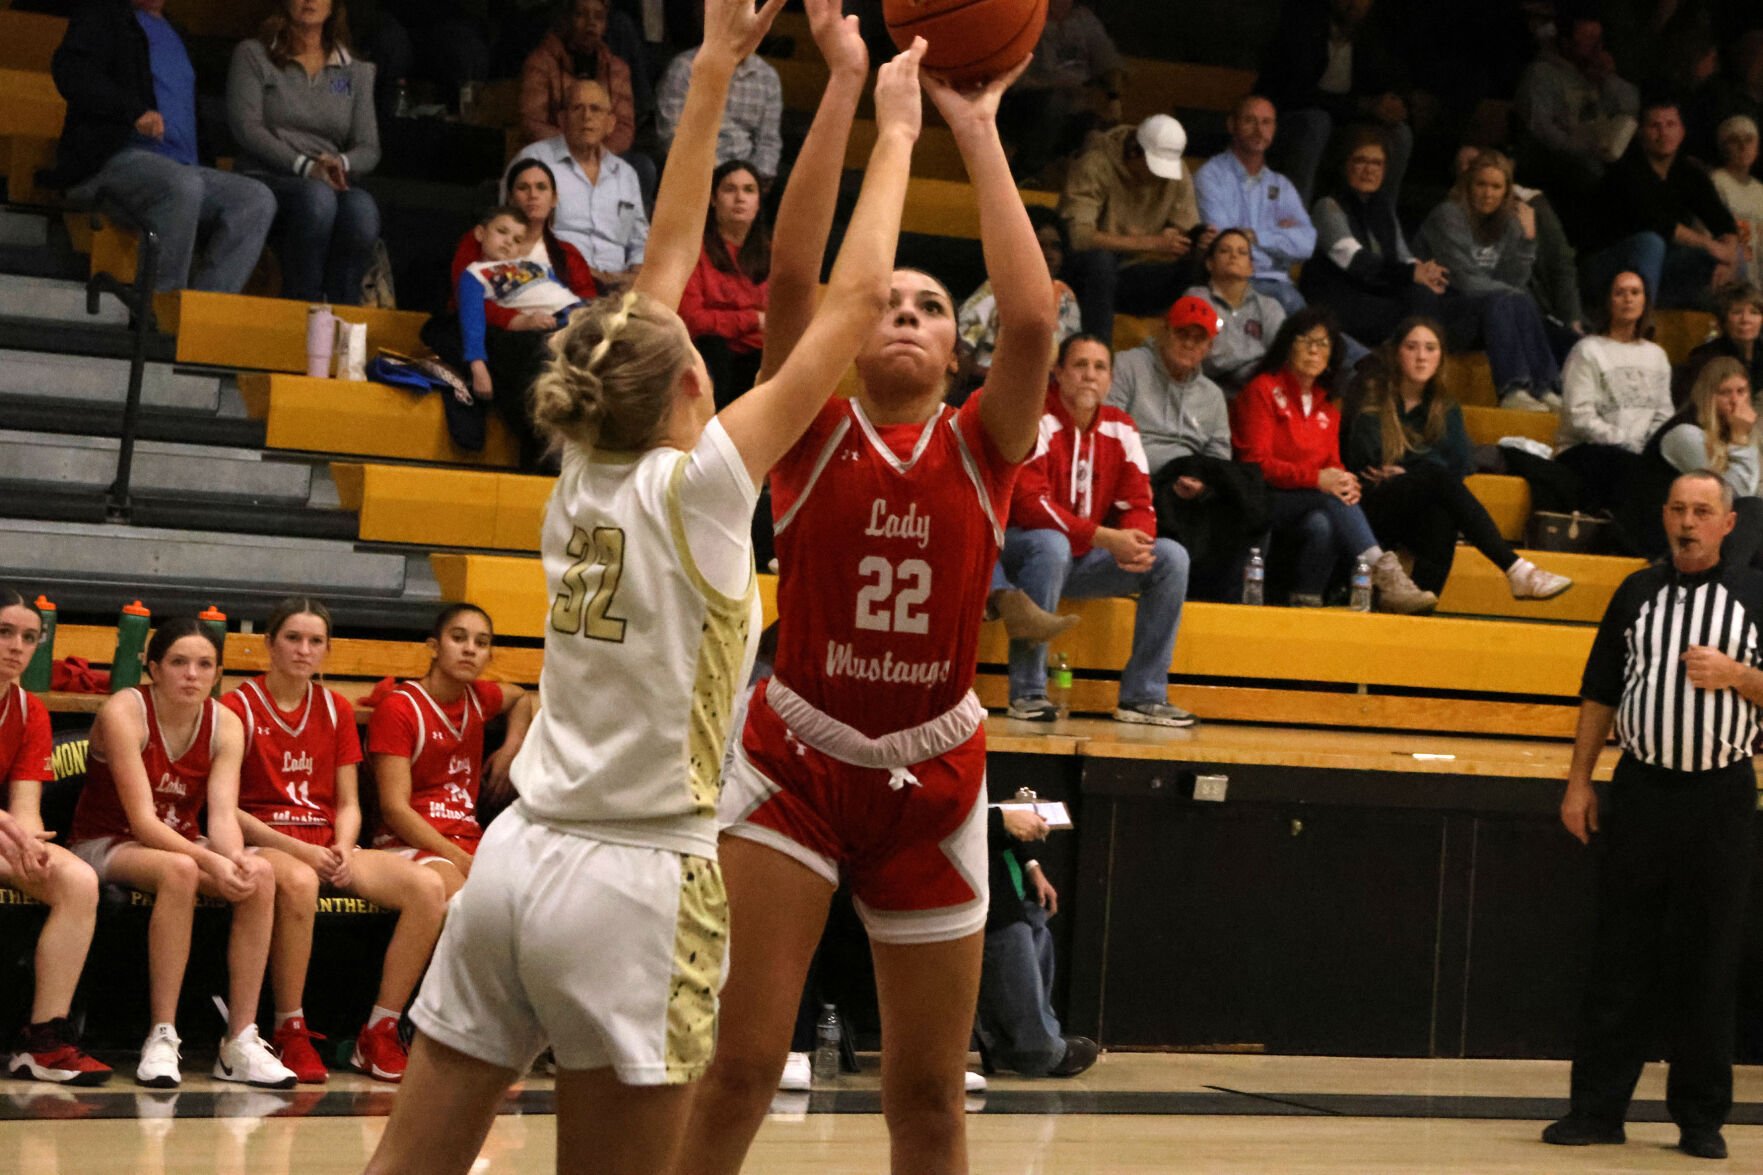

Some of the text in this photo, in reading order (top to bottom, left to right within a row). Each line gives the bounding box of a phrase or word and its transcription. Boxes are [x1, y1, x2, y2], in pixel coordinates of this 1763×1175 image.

[865, 498, 931, 549] Lady
[551, 525, 627, 643] 32
[855, 555, 932, 635] 22
[281, 750, 313, 776] Lady
[286, 781, 320, 810] 11
